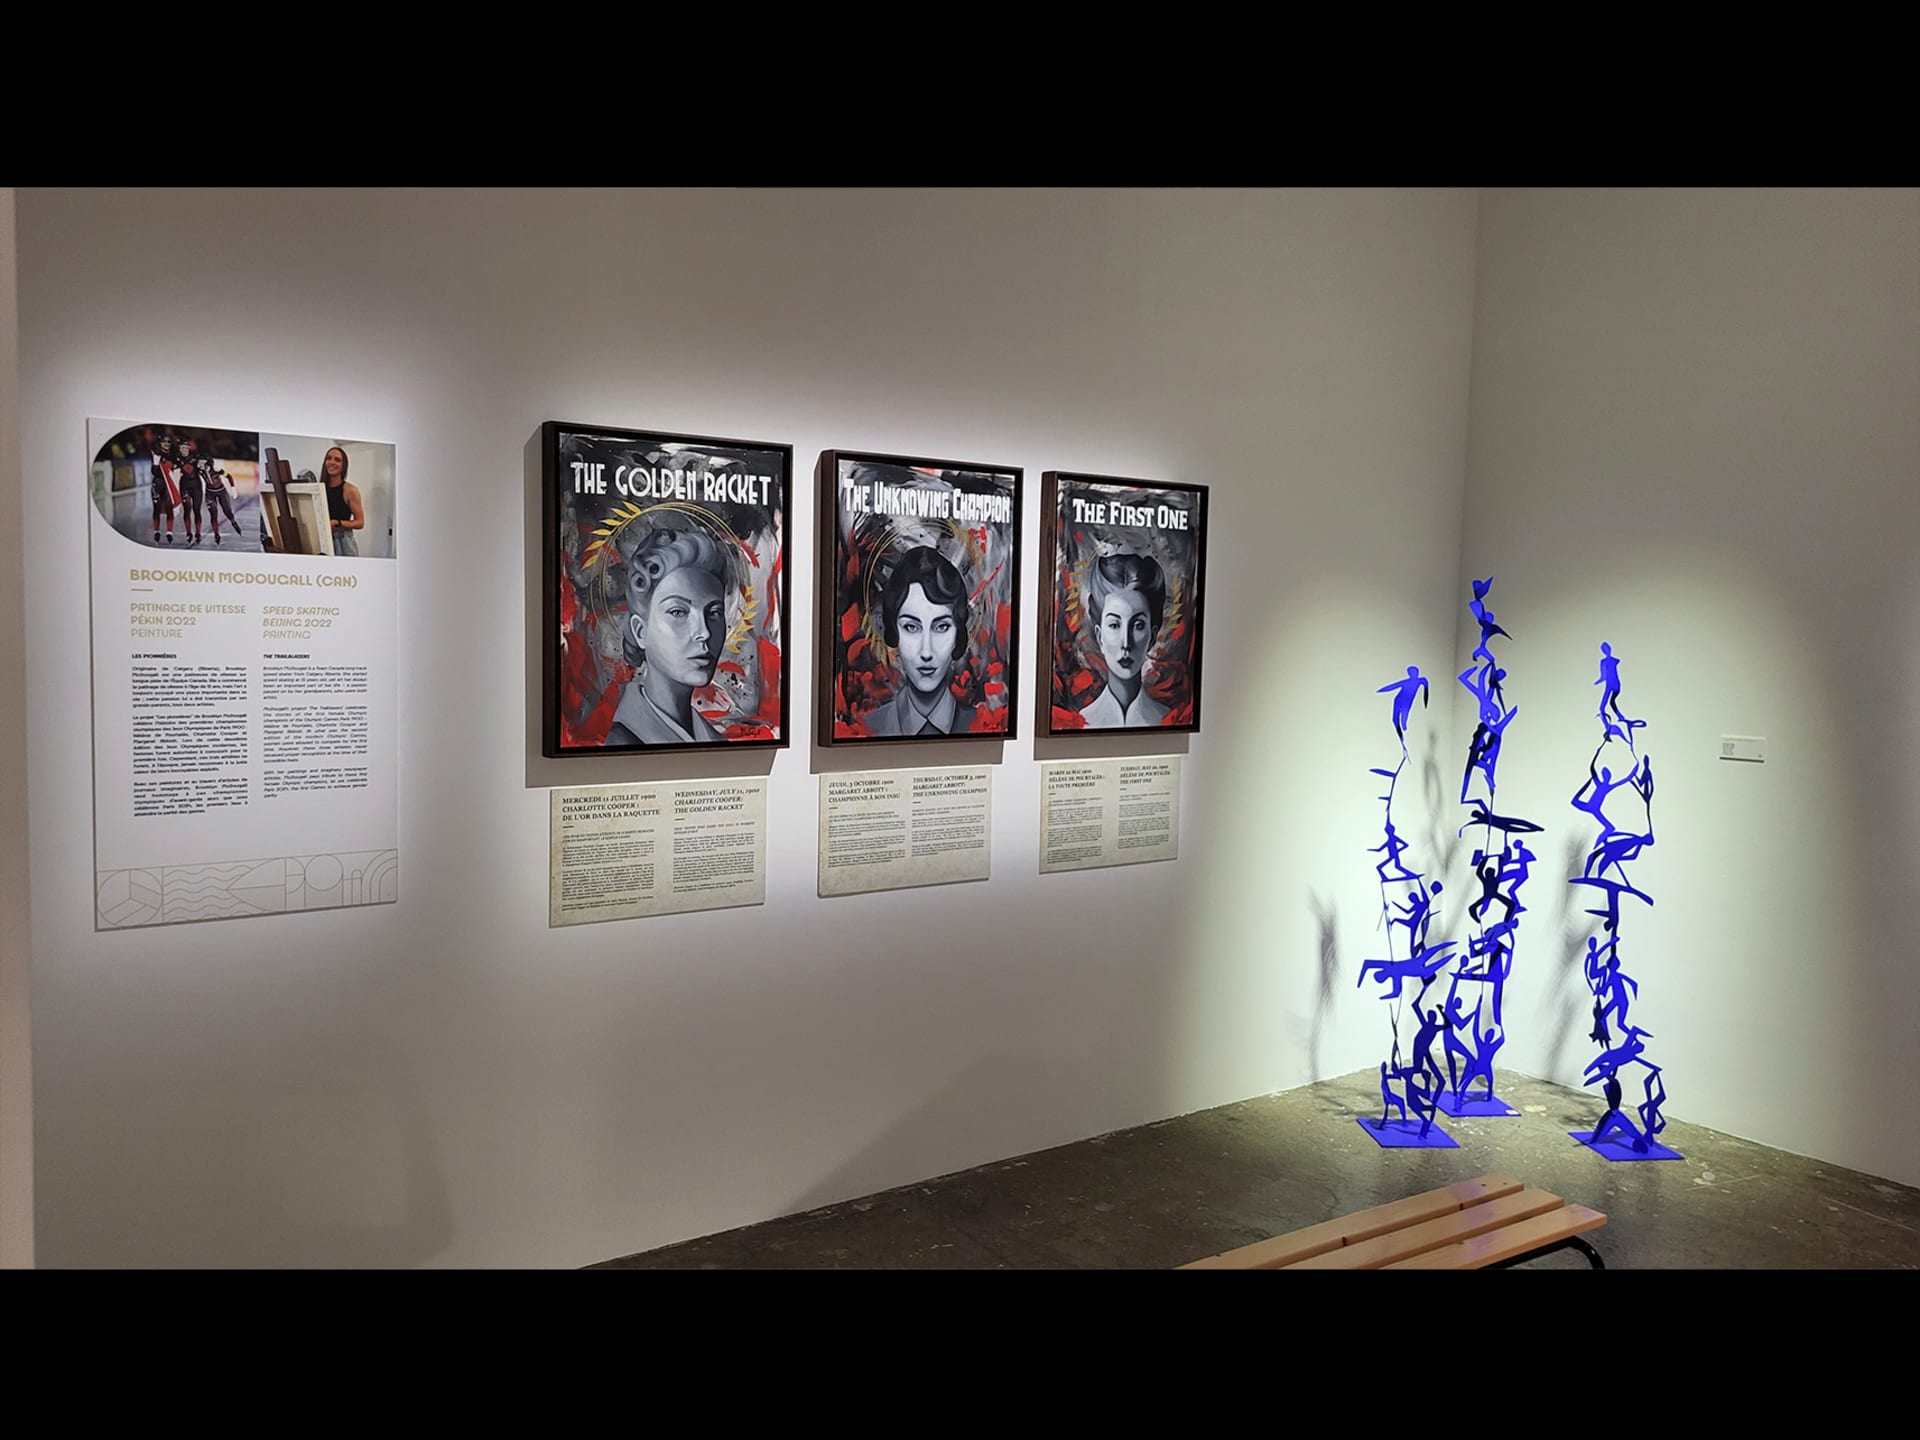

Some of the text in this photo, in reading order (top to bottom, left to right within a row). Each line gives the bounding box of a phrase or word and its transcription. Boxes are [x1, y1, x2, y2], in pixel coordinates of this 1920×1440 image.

[570, 462, 771, 506] THE GOLDEN RACKET
[844, 479, 1011, 523] THE UNKNOWING CHAMPION
[1073, 498, 1188, 530] THE FIRST ONE
[130, 569, 357, 588] BROOKLYN MCDOUGALL (CAN)
[130, 603, 246, 614] PATINAGE DE VITESSE
[262, 606, 340, 616] SPEED SKATING
[131, 614, 196, 625] PÉKIN 2022
[262, 618, 332, 628] BEIJING 2022
[131, 628, 183, 638] PEINTURE
[263, 630, 311, 640] PAINTING
[624, 810, 660, 818] RAQUETTE
